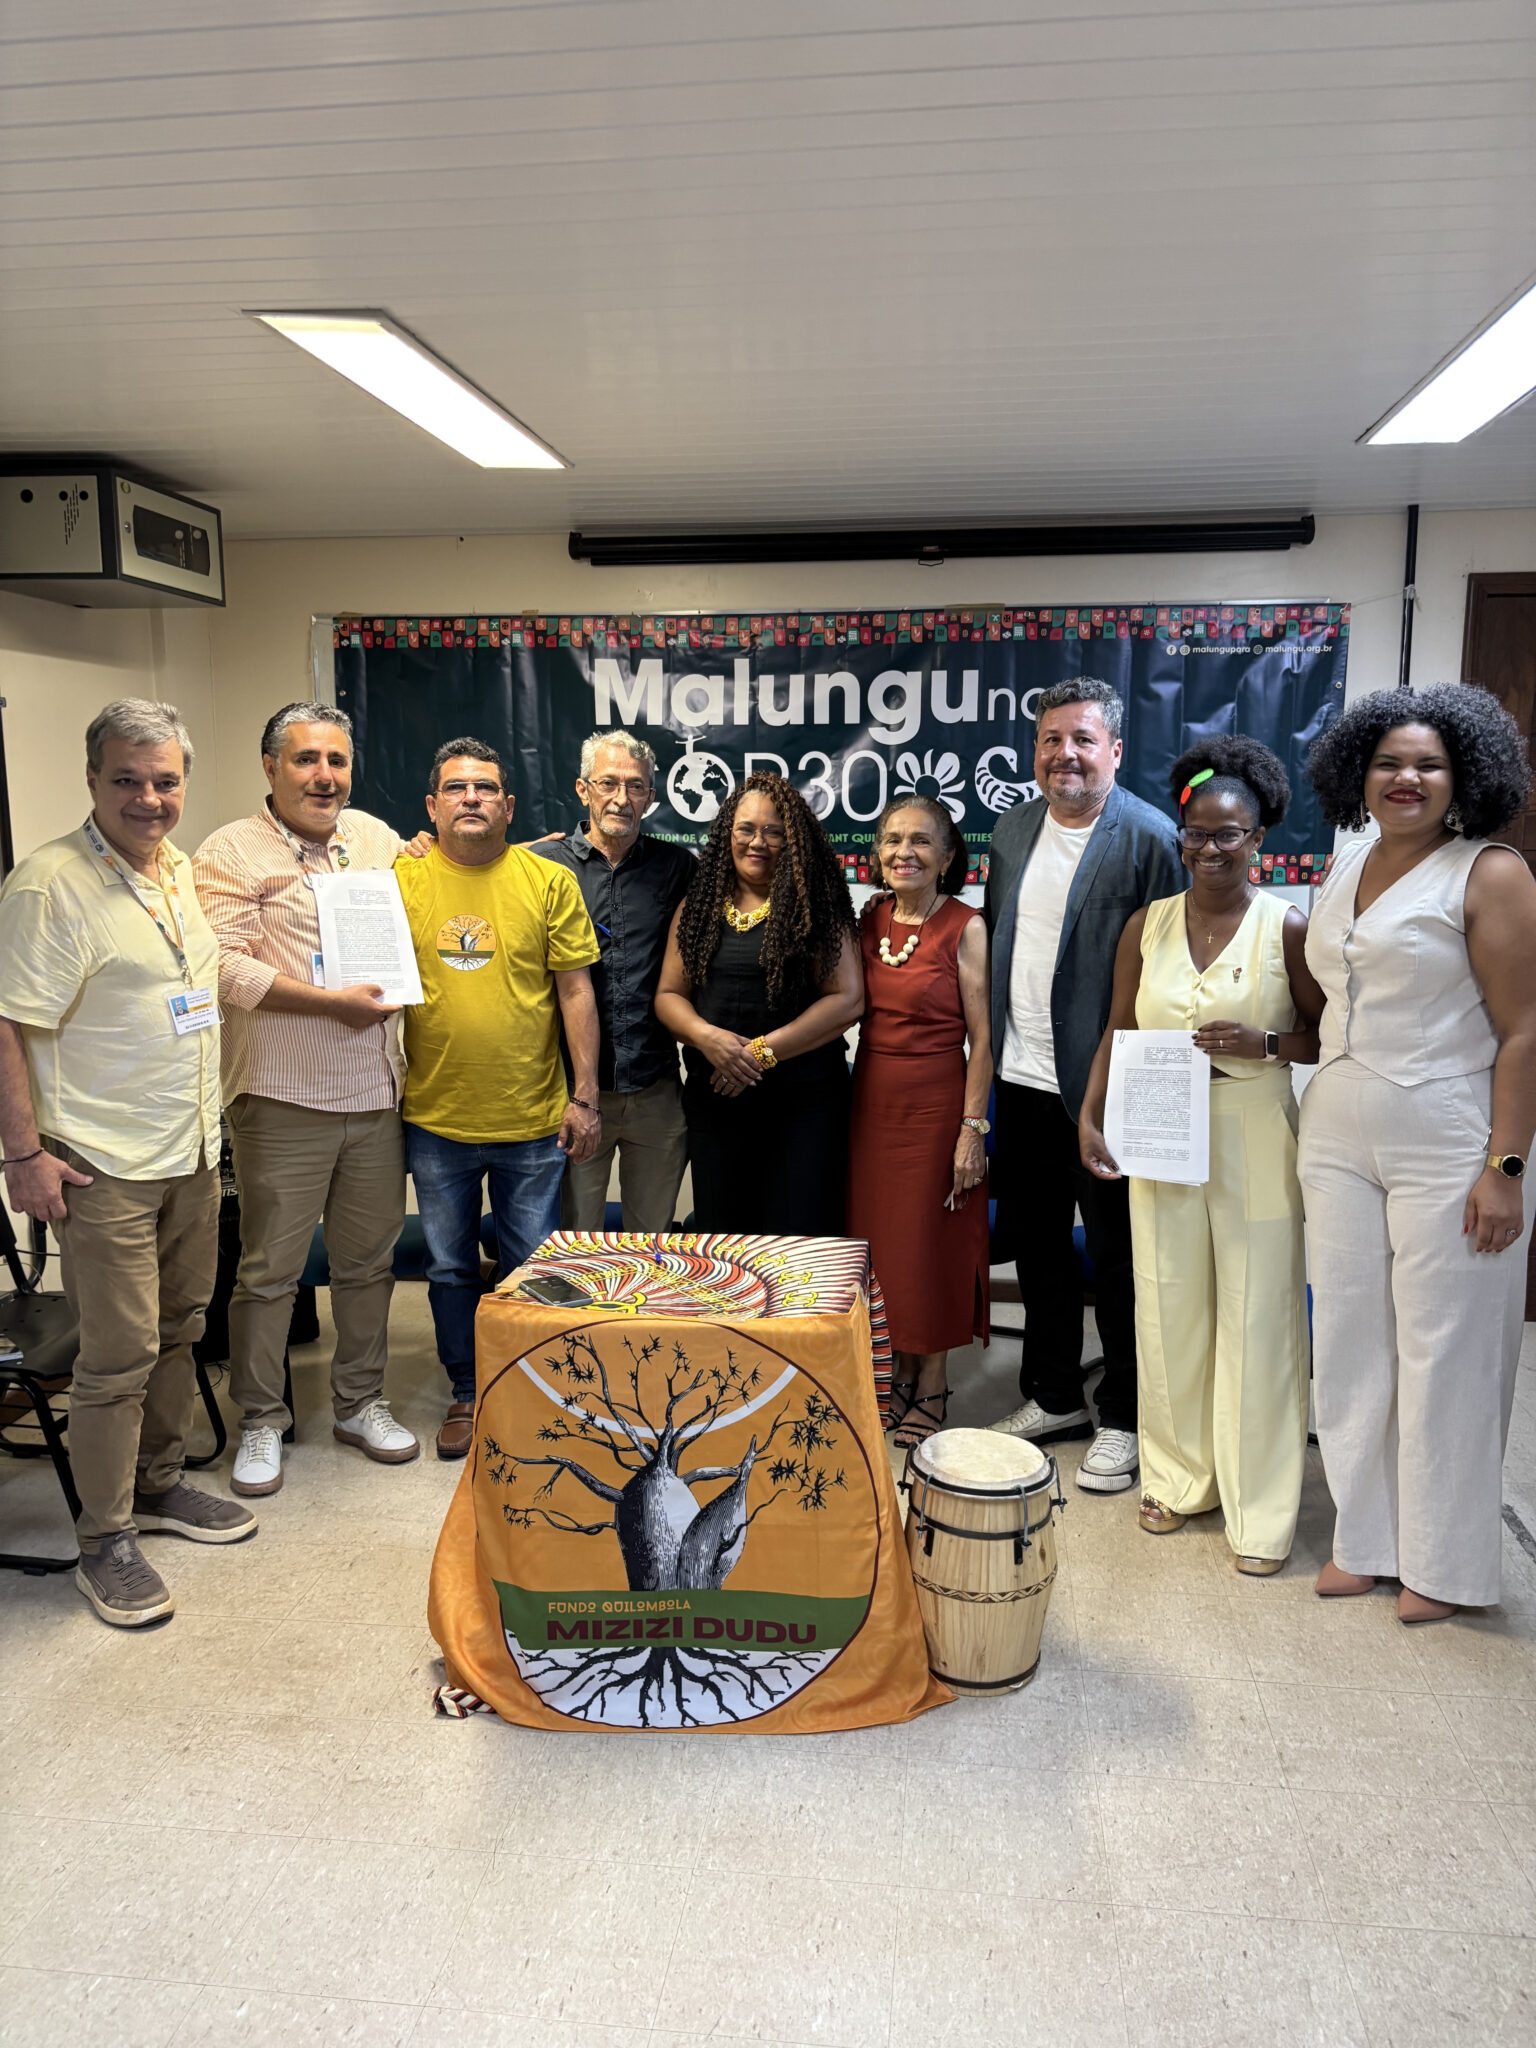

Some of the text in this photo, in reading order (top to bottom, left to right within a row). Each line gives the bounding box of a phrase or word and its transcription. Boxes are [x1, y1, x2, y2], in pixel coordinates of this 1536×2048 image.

[1192, 646, 1251, 655] malungupara
[1265, 644, 1333, 654] malungu.org.br
[594, 658, 979, 746] Malungu
[642, 833, 679, 843] ATION
[682, 833, 696, 843] OF
[828, 833, 849, 843] ANT
[851, 833, 876, 845] QUI
[548, 1599, 692, 1613] FUNDO QUILOMBOLA
[547, 1616, 817, 1645] MIZIZI DUDU
